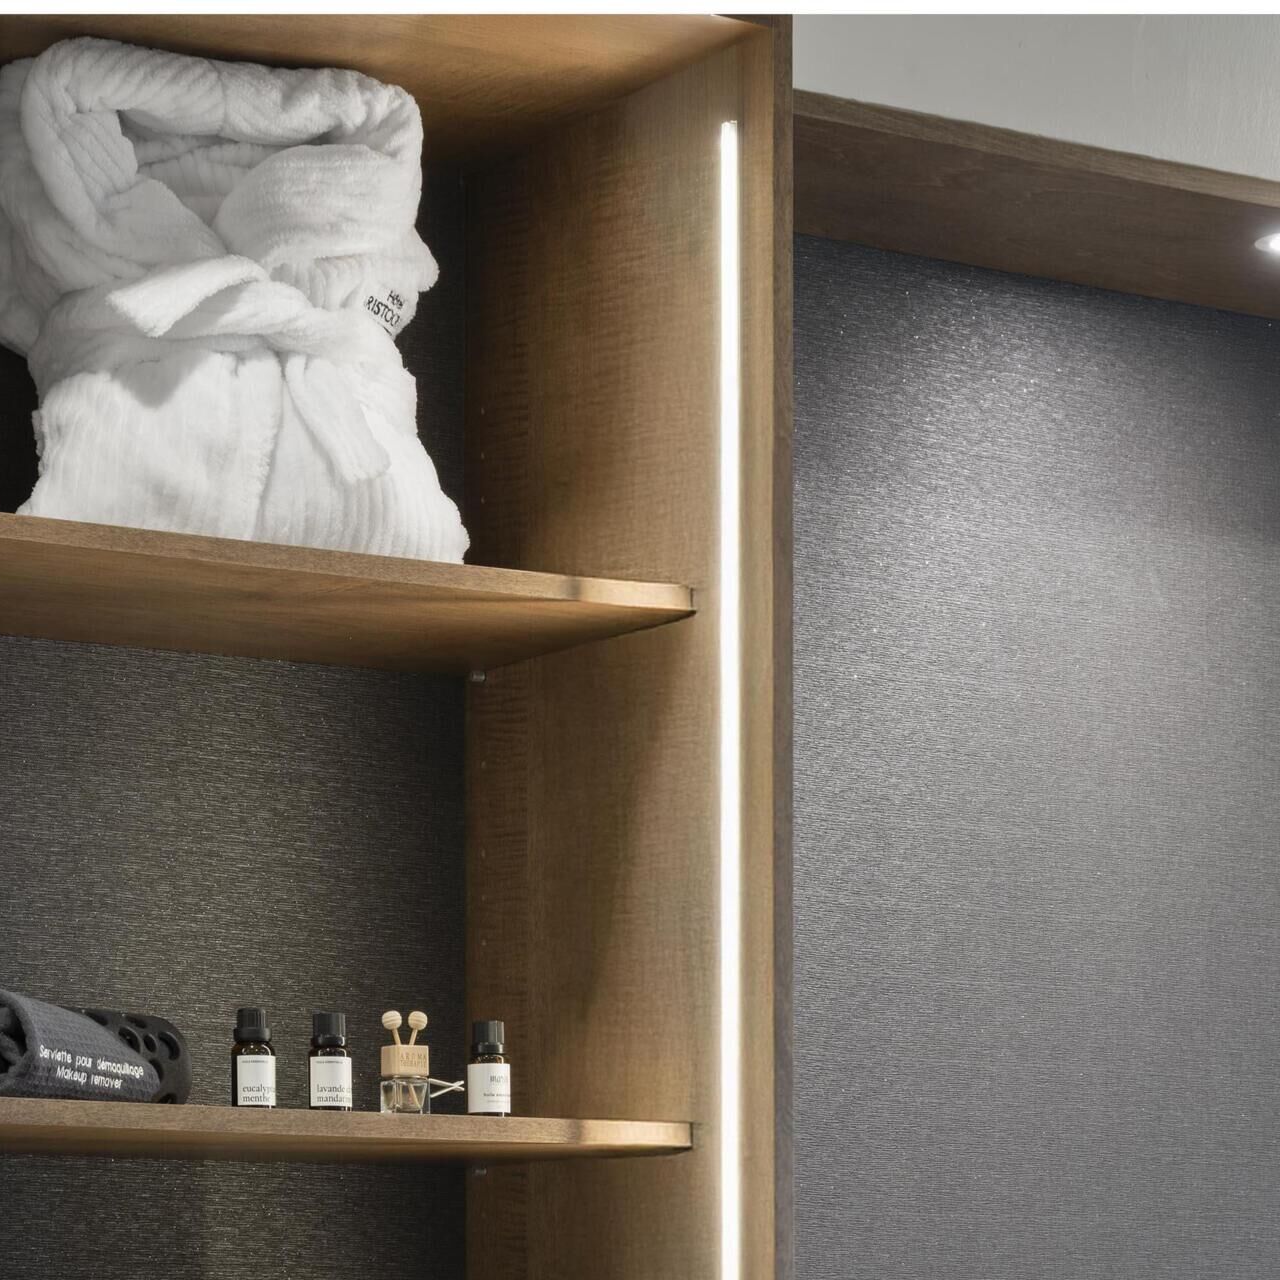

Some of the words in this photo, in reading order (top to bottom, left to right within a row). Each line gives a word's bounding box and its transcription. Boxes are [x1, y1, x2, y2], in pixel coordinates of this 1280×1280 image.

[39, 1044, 72, 1063] Serviette
[75, 1055, 93, 1068] pour
[97, 1056, 144, 1079] démaquillage
[56, 1065, 88, 1085] Makeup
[90, 1074, 123, 1089] remover
